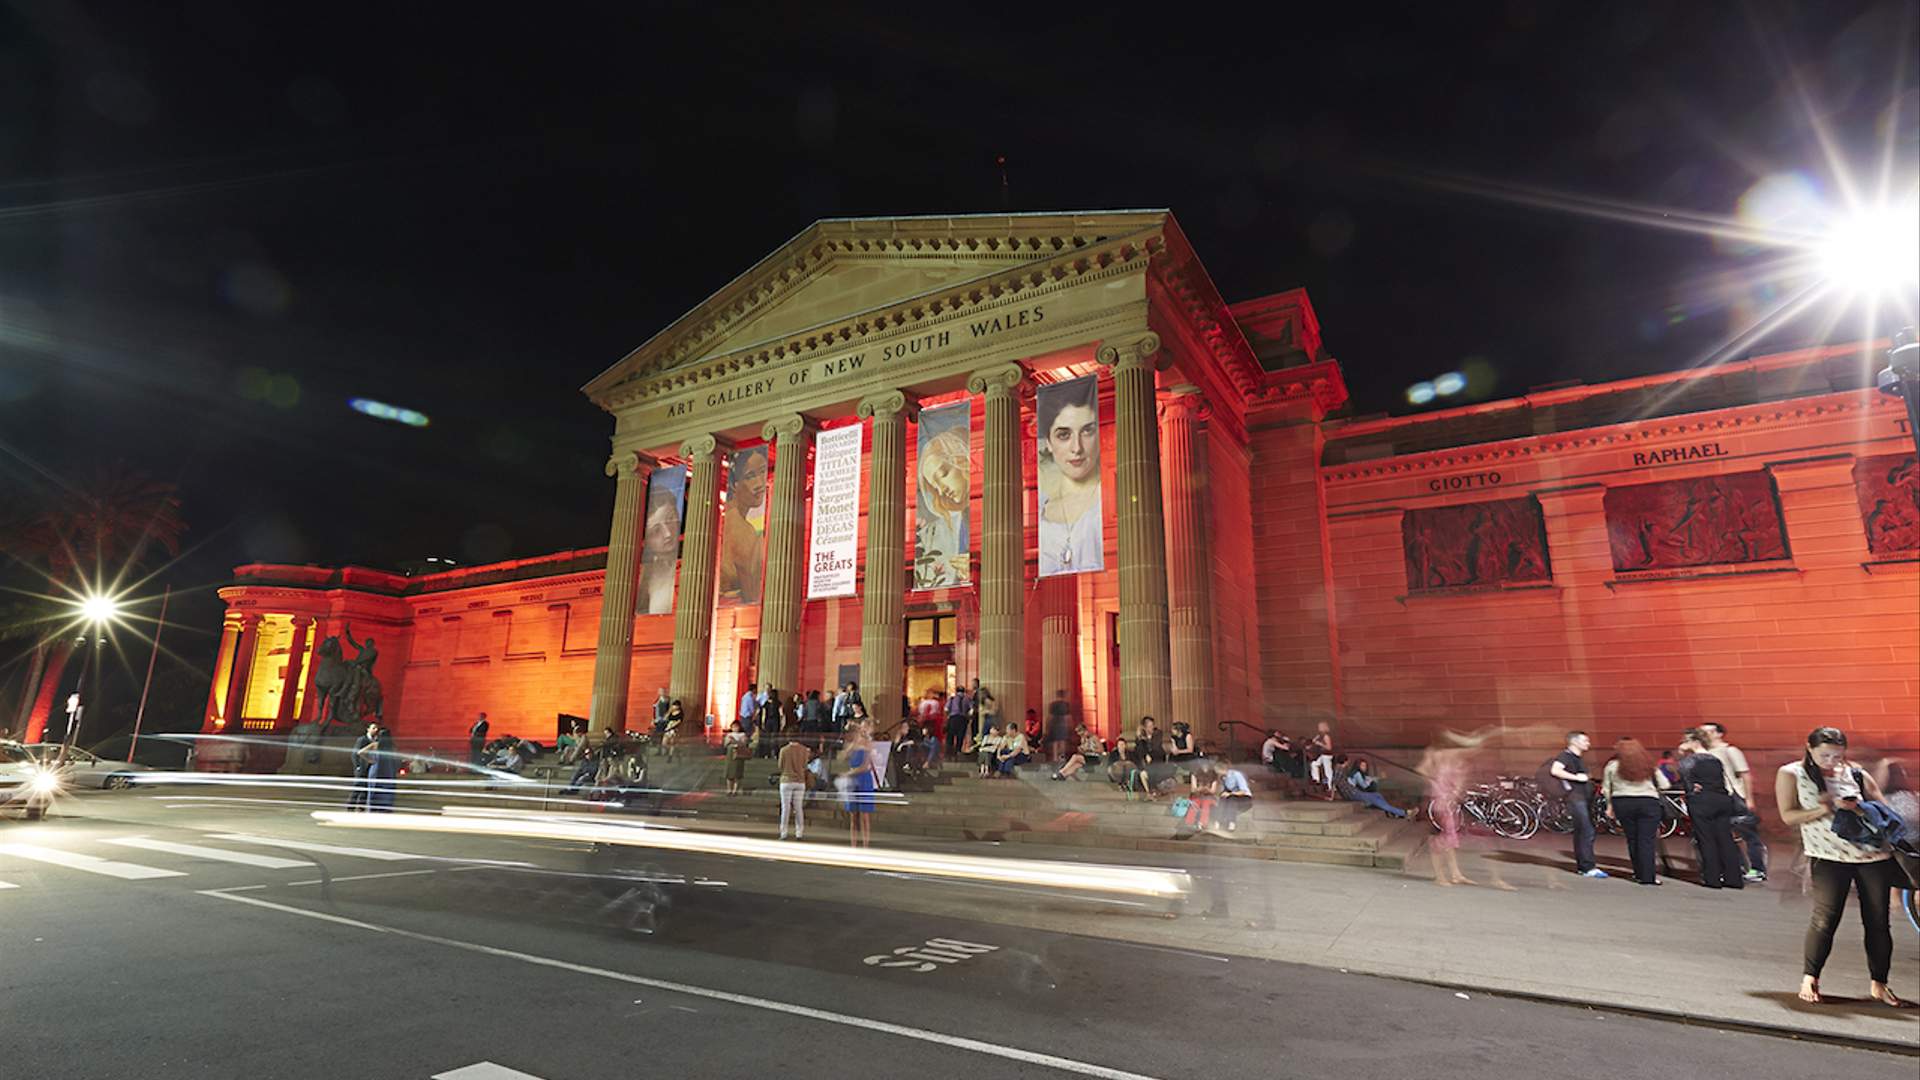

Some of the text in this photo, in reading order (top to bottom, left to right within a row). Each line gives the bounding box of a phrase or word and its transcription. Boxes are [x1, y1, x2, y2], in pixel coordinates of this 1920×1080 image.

[666, 306, 1045, 419] ART GALLERY OF NEW SOUTH WALES
[820, 455, 857, 471] TITIAN
[1633, 443, 1729, 467] RAPHAEL
[819, 467, 857, 479] VERMEER
[1429, 471, 1502, 492] GIOTTO
[817, 490, 855, 504] Sargent
[817, 501, 855, 516] Monet
[816, 520, 854, 536] DEGAS
[815, 550, 836, 562] THE
[814, 557, 853, 573] GREATS
[863, 937, 1001, 972] BUS
